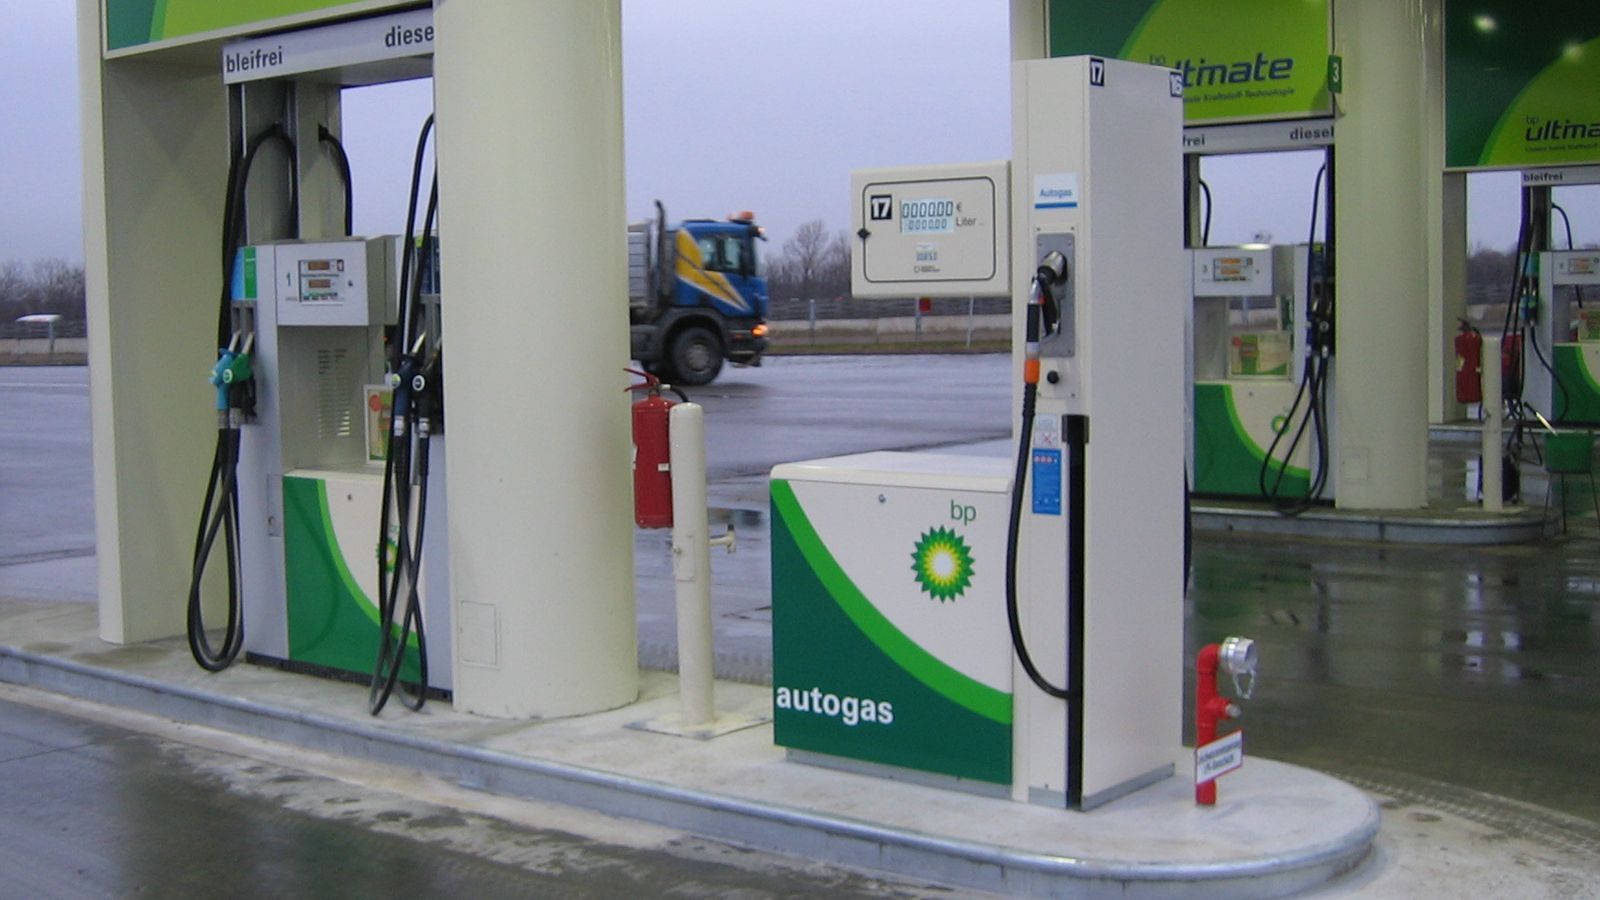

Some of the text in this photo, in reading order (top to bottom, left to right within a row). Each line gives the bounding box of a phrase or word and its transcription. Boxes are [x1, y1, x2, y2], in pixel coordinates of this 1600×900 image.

[385, 25, 434, 47] diese
[226, 46, 282, 73] bleifrei
[1174, 52, 1293, 88] timate
[1091, 61, 1103, 84] 17
[1331, 67, 1340, 83] 3
[1171, 74, 1183, 97] 16
[1289, 127, 1335, 141] diesel
[1525, 119, 1600, 141] ultima
[1523, 171, 1563, 182] bleifrei
[1040, 187, 1073, 200] Autogas
[872, 197, 891, 218] 17
[950, 499, 977, 526] bp
[776, 686, 894, 726] autogas
